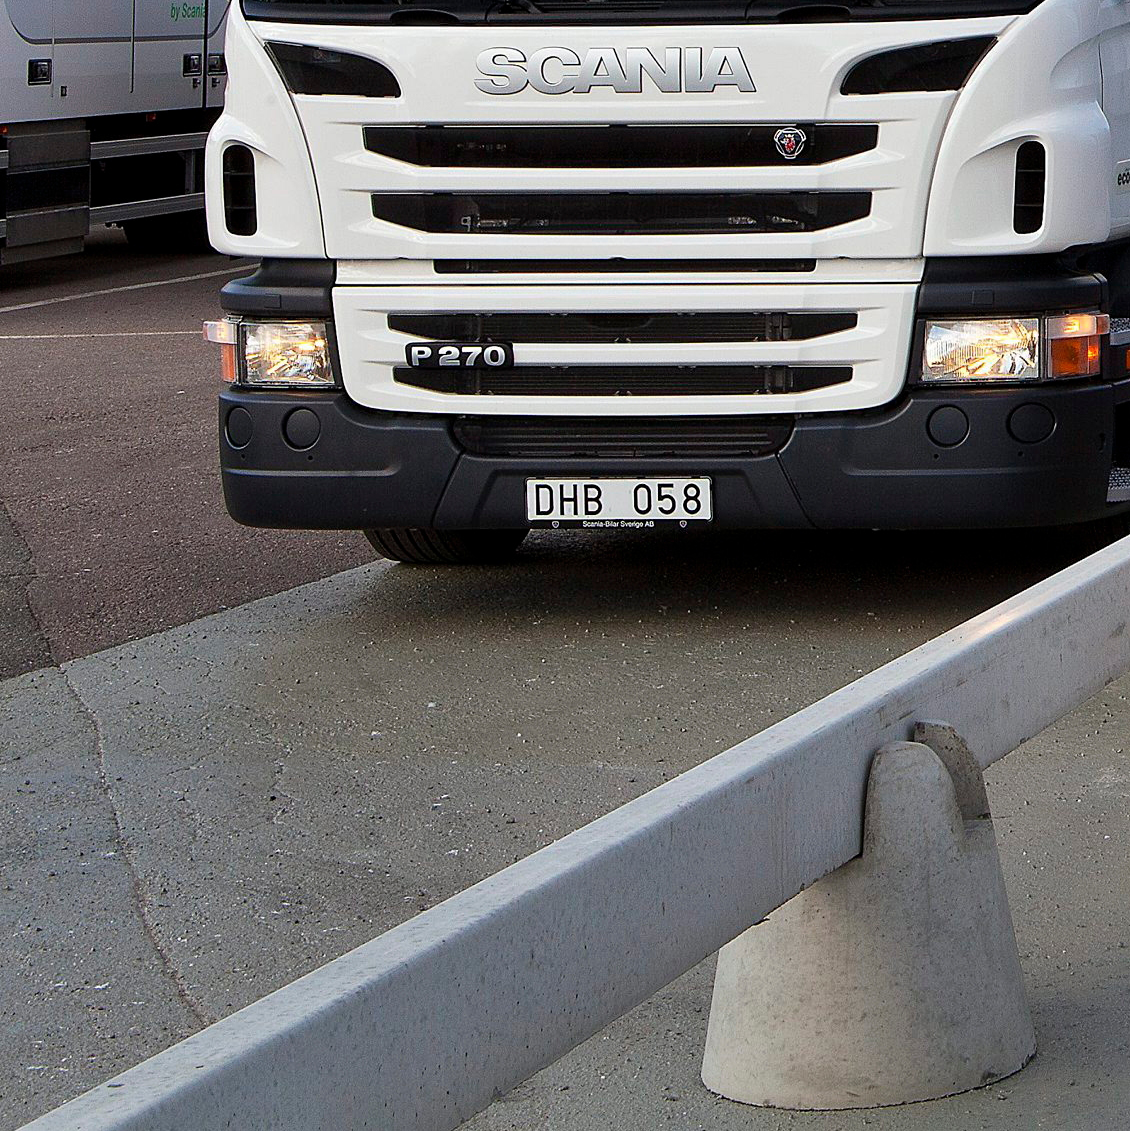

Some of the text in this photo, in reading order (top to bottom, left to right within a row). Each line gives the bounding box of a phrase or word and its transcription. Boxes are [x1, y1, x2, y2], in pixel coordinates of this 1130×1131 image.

[170, 2, 180, 21] by
[473, 46, 757, 95] SCANIA
[411, 345, 506, 367] P 270
[535, 483, 702, 516] DHB 058
[582, 520, 655, 529] Scania-Bilar Sverige AB
